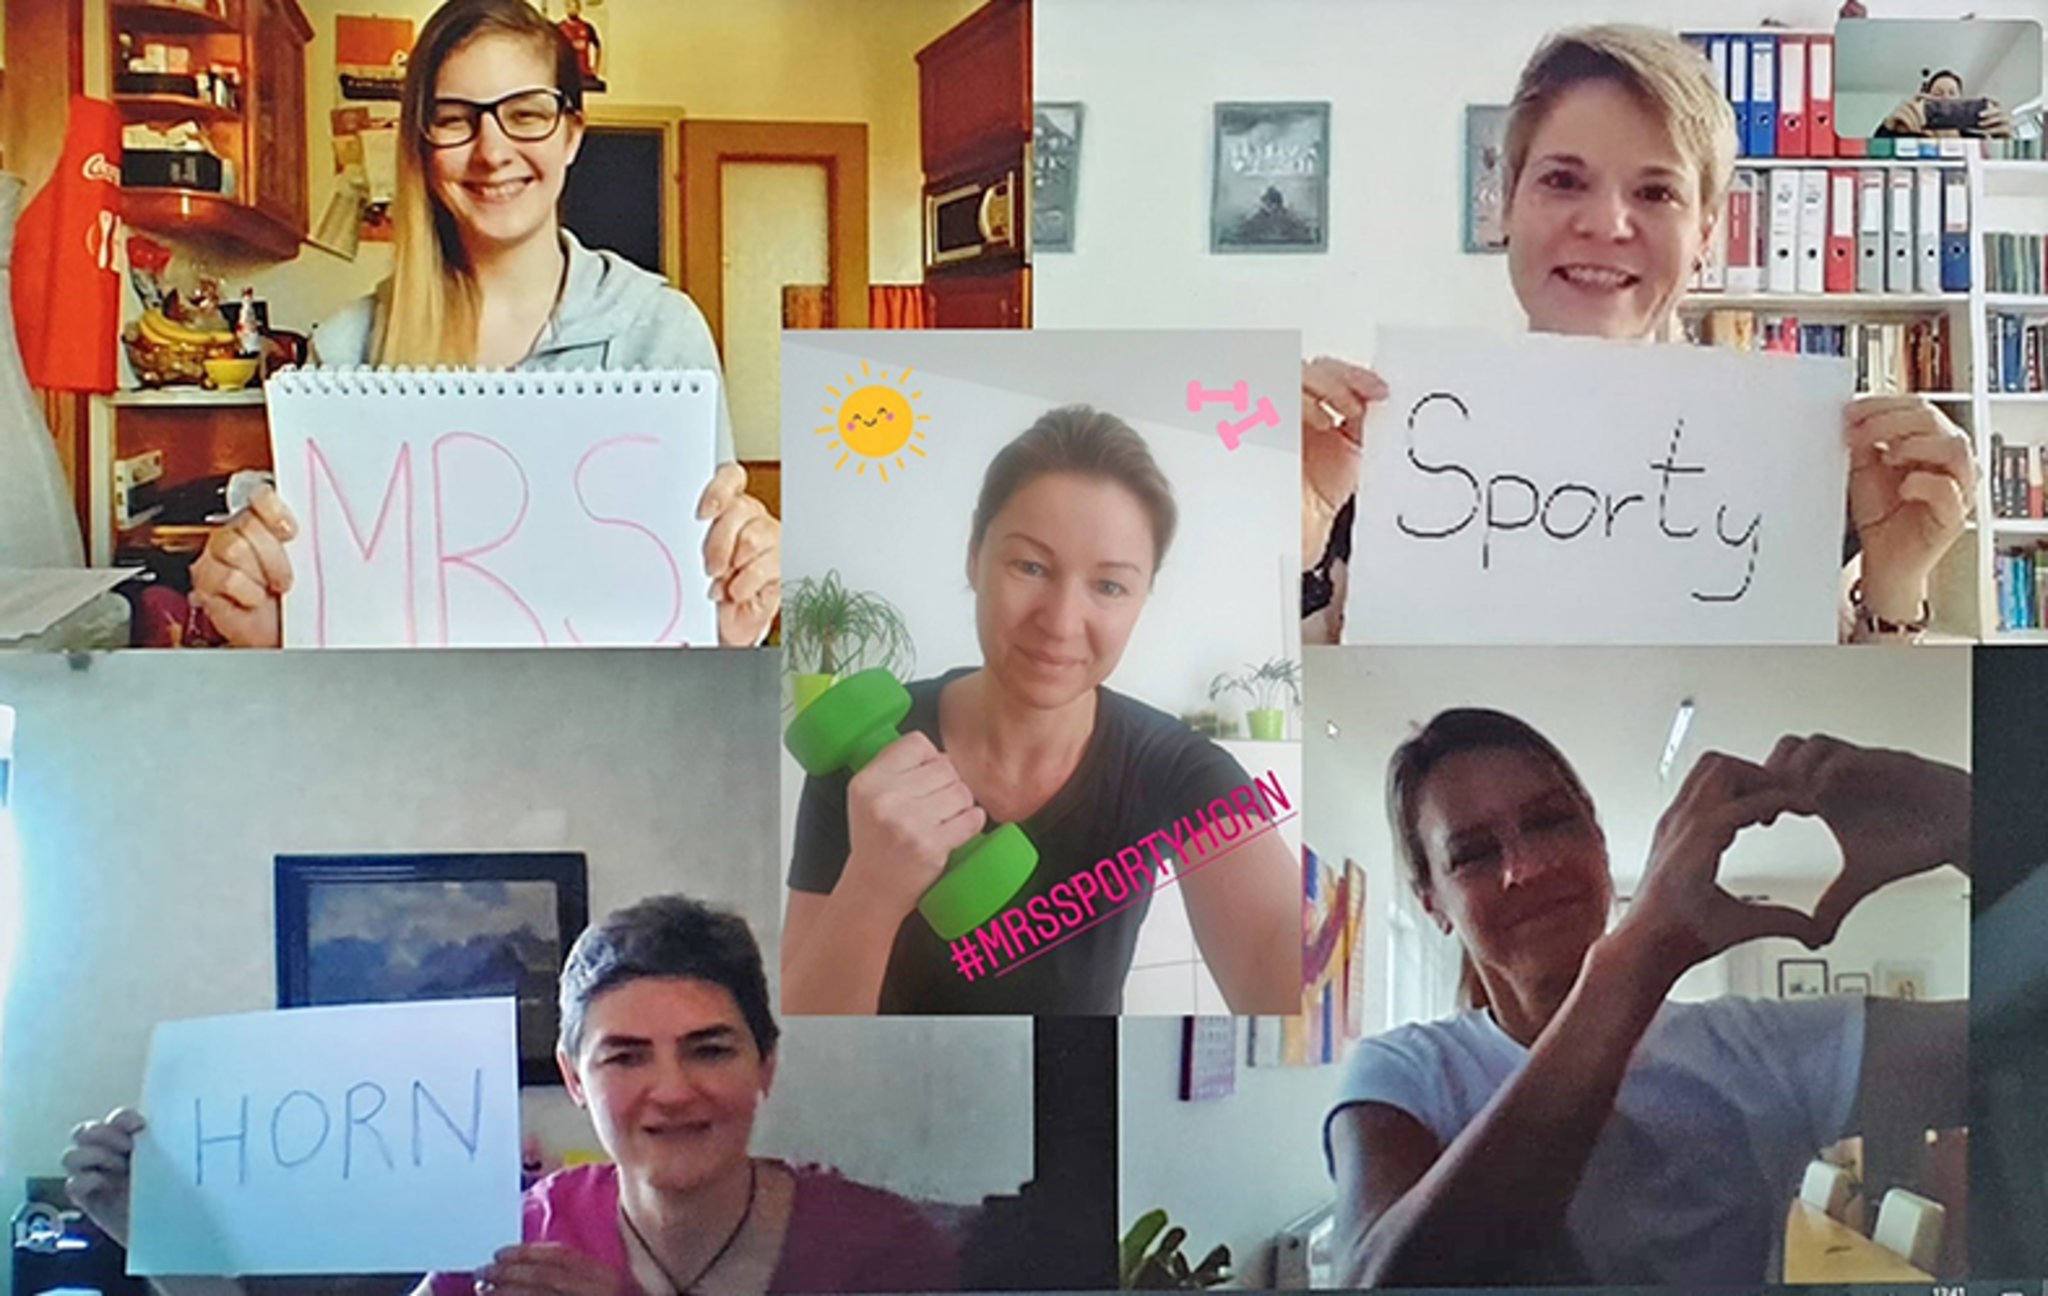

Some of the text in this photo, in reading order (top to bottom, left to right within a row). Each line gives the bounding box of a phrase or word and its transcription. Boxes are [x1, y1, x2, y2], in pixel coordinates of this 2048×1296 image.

[305, 430, 684, 647] MRS
[1396, 391, 1763, 602] Sporty
[194, 1067, 483, 1187] HORN
